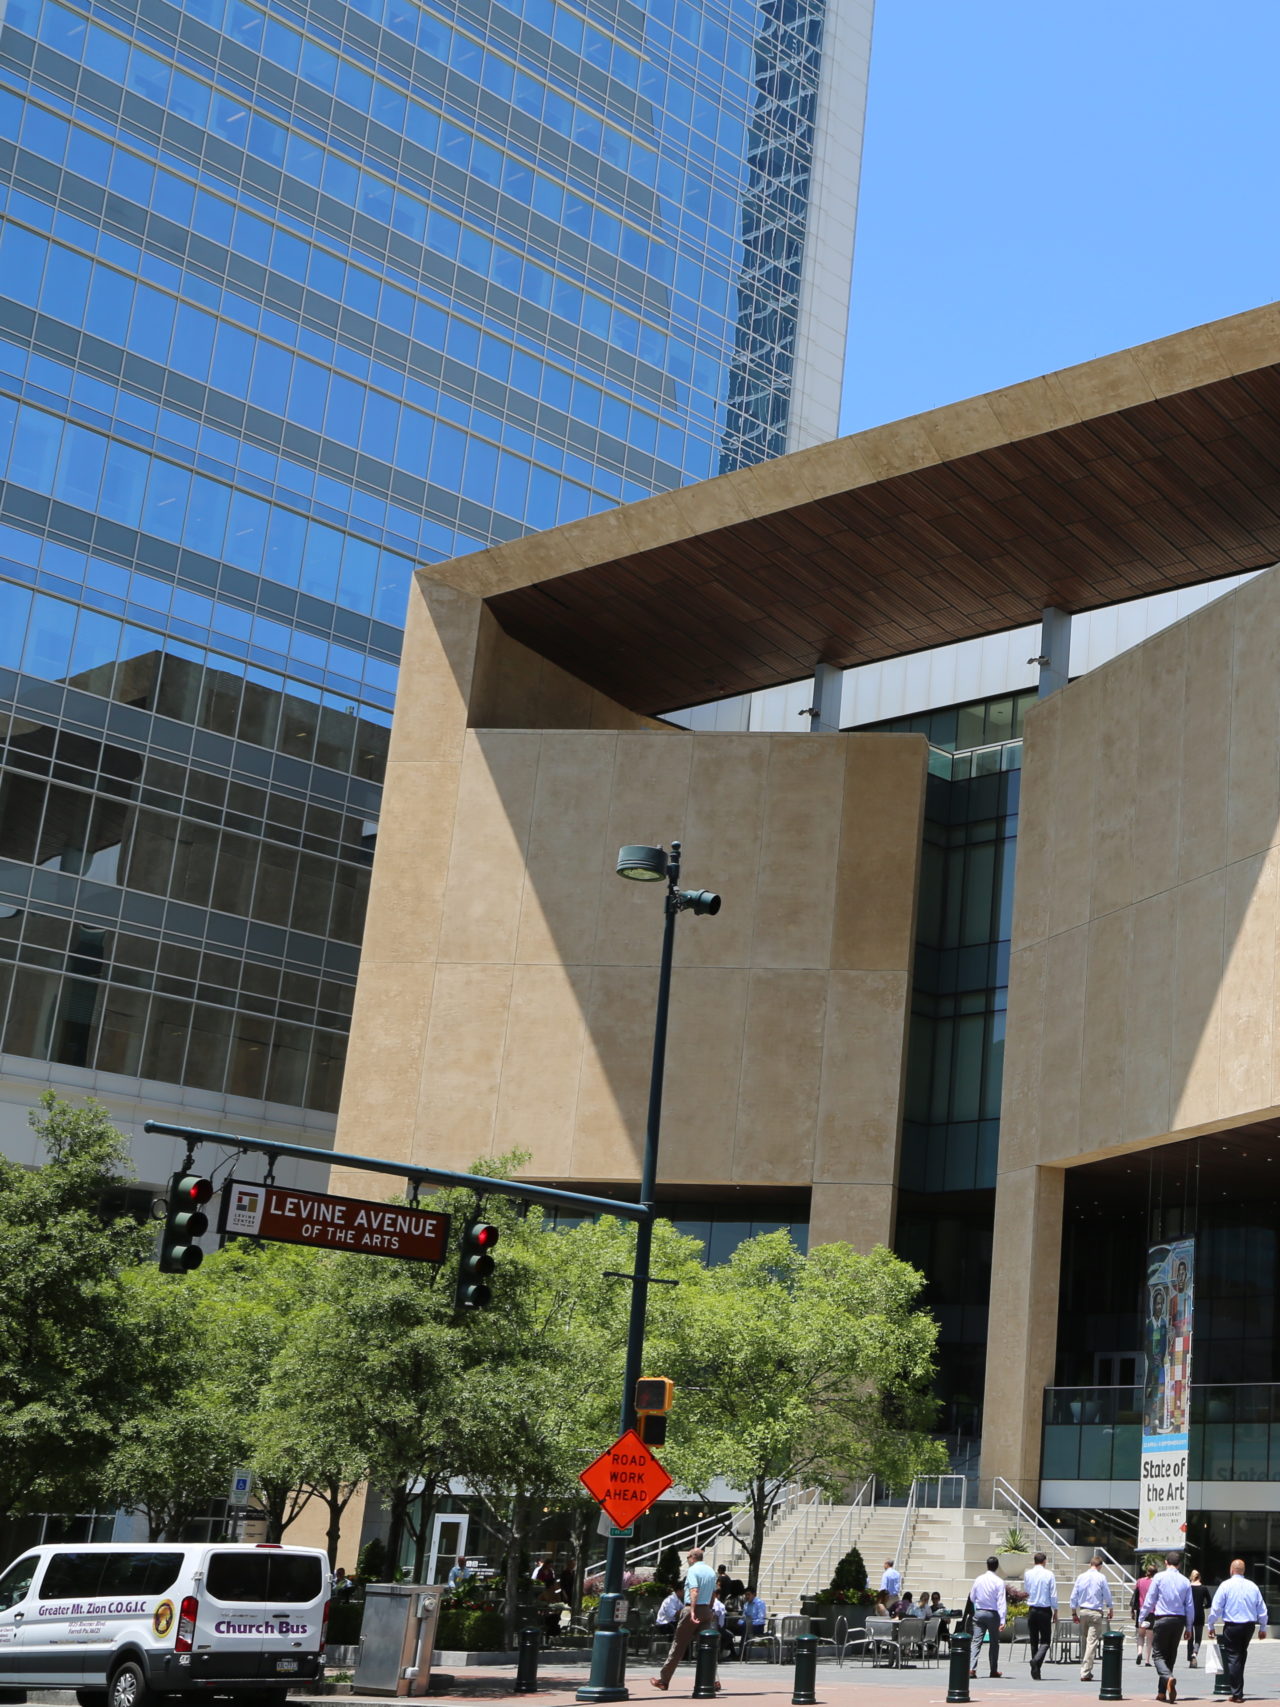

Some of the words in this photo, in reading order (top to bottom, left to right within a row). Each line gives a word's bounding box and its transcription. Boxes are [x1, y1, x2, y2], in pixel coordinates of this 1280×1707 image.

[270, 1195, 347, 1225] LEVINE
[353, 1209, 438, 1238] AVENUE
[302, 1224, 323, 1238] OF
[326, 1227, 356, 1244] THE
[361, 1232, 400, 1249] ARTS
[612, 1454, 646, 1466] ROAD
[1143, 1460, 1171, 1478] State
[1173, 1457, 1185, 1476] of
[609, 1472, 645, 1483] WORK
[605, 1489, 647, 1501] AHEAD
[1147, 1484, 1164, 1502] the
[1166, 1482, 1184, 1501] Art
[38, 1605, 69, 1616] Greater
[71, 1604, 85, 1614] Mt.
[86, 1603, 106, 1614] Zion
[108, 1601, 146, 1613] C.O.G.I.C
[215, 1621, 274, 1634] Church
[278, 1621, 307, 1634] Bus
